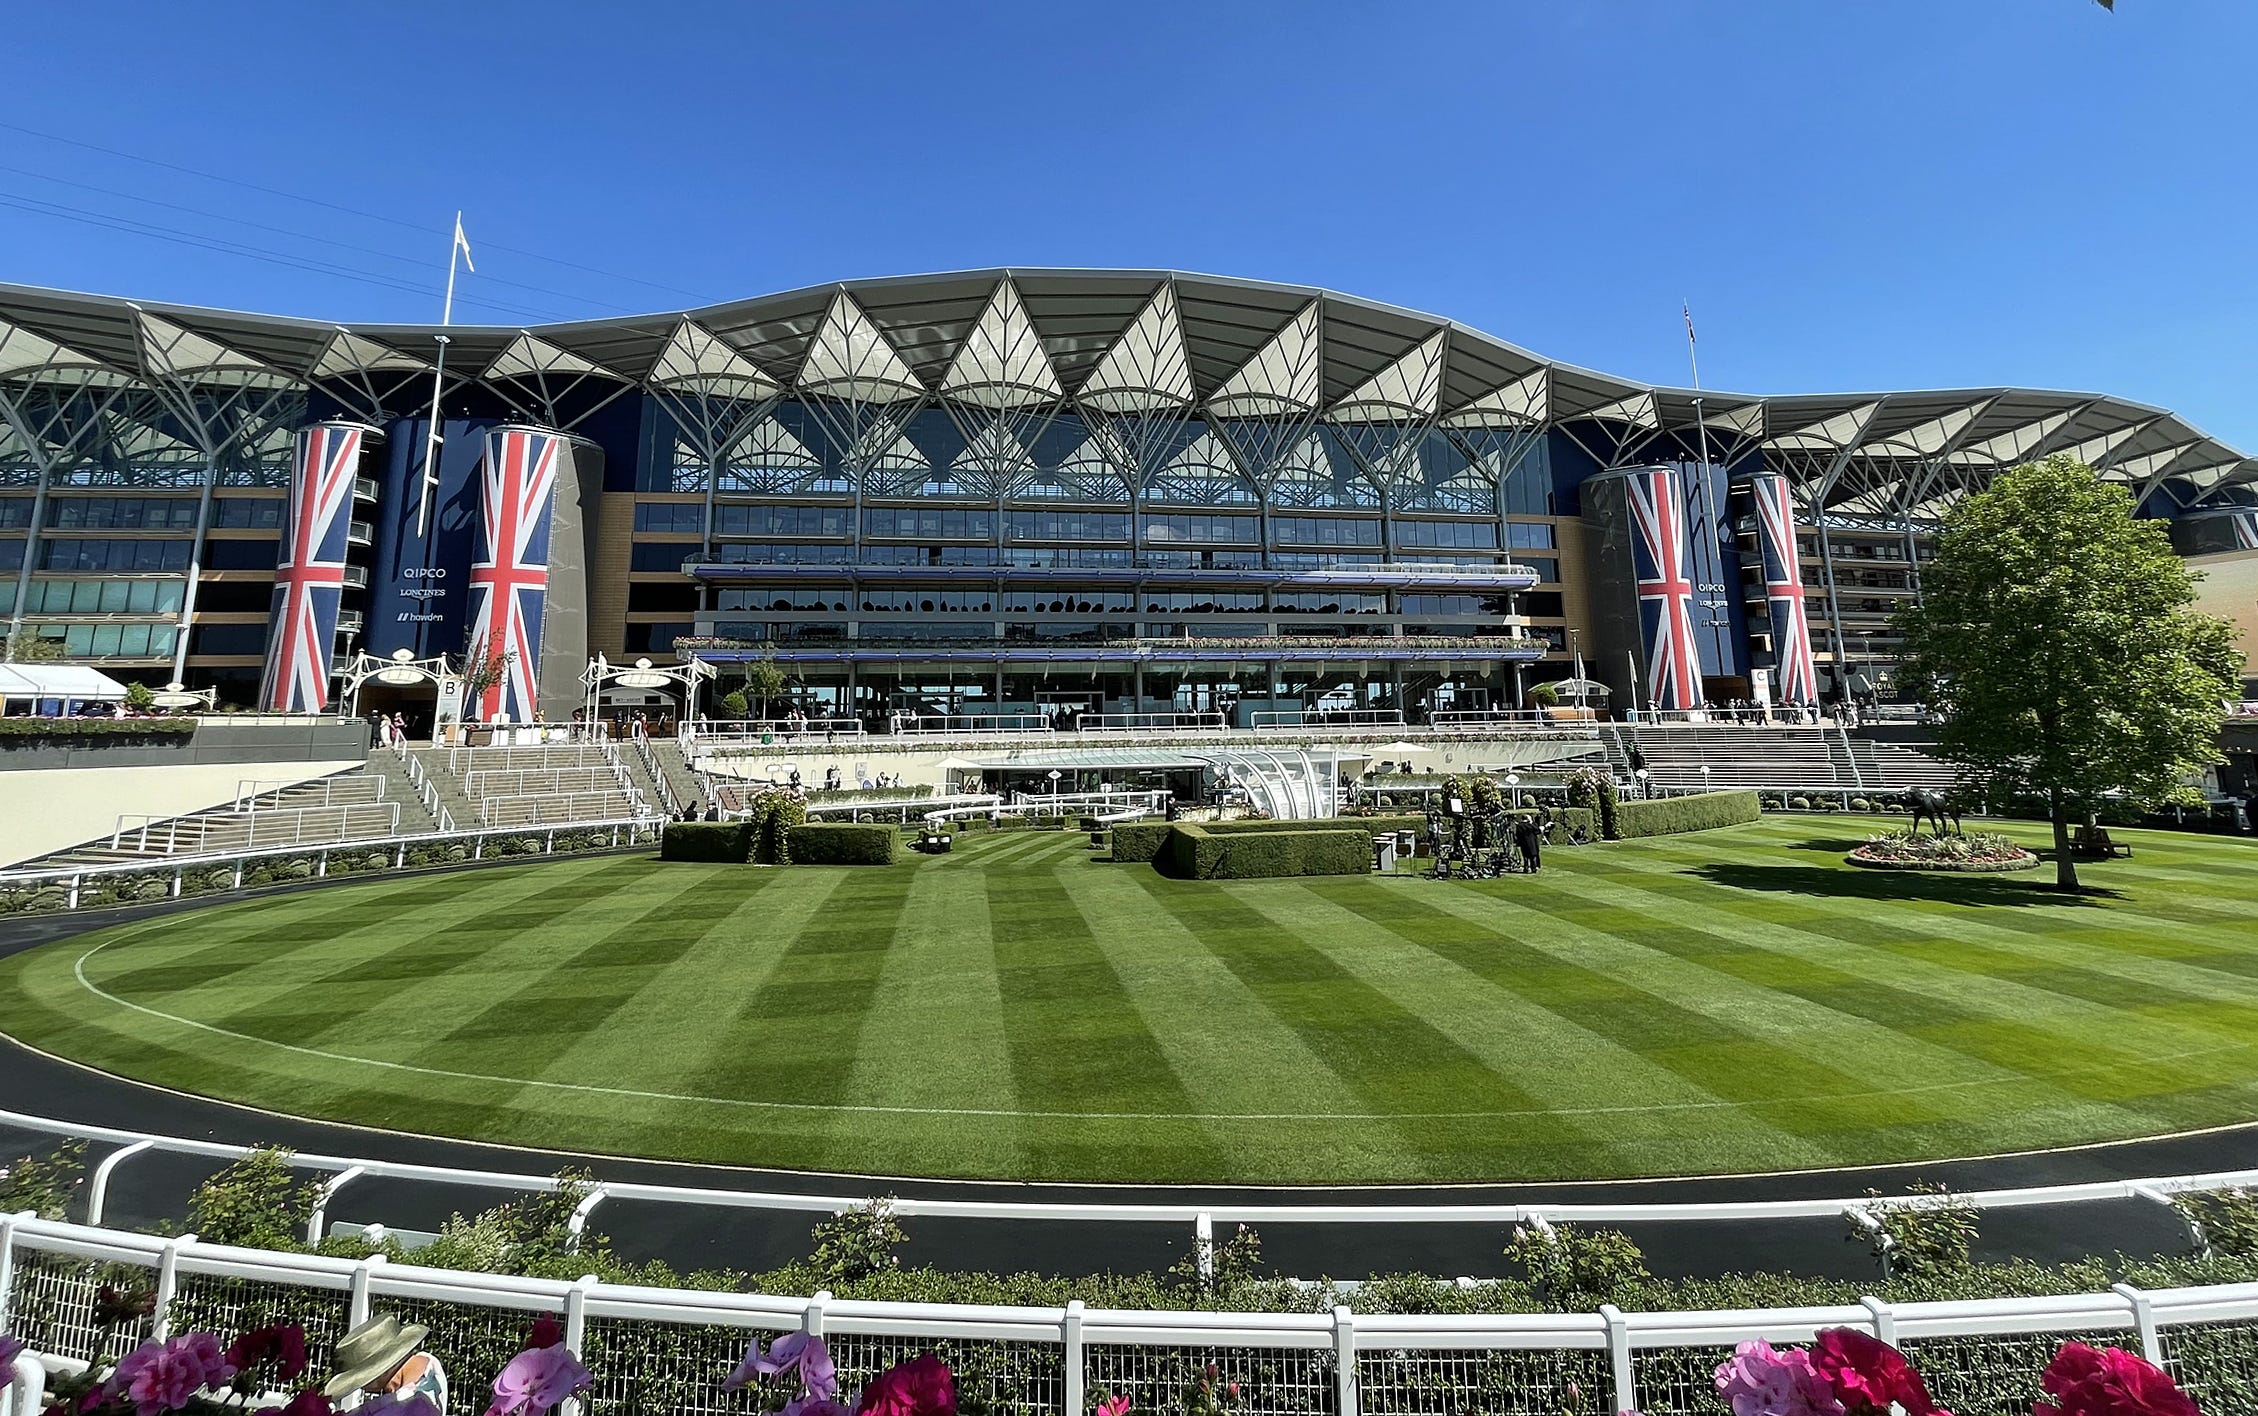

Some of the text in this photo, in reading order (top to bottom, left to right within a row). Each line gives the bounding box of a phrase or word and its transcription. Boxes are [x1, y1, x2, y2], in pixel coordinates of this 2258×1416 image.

[404, 568, 446, 579] QIPCO
[410, 612, 443, 621] howden
[1757, 671, 1766, 681] C
[446, 682, 455, 695] B
